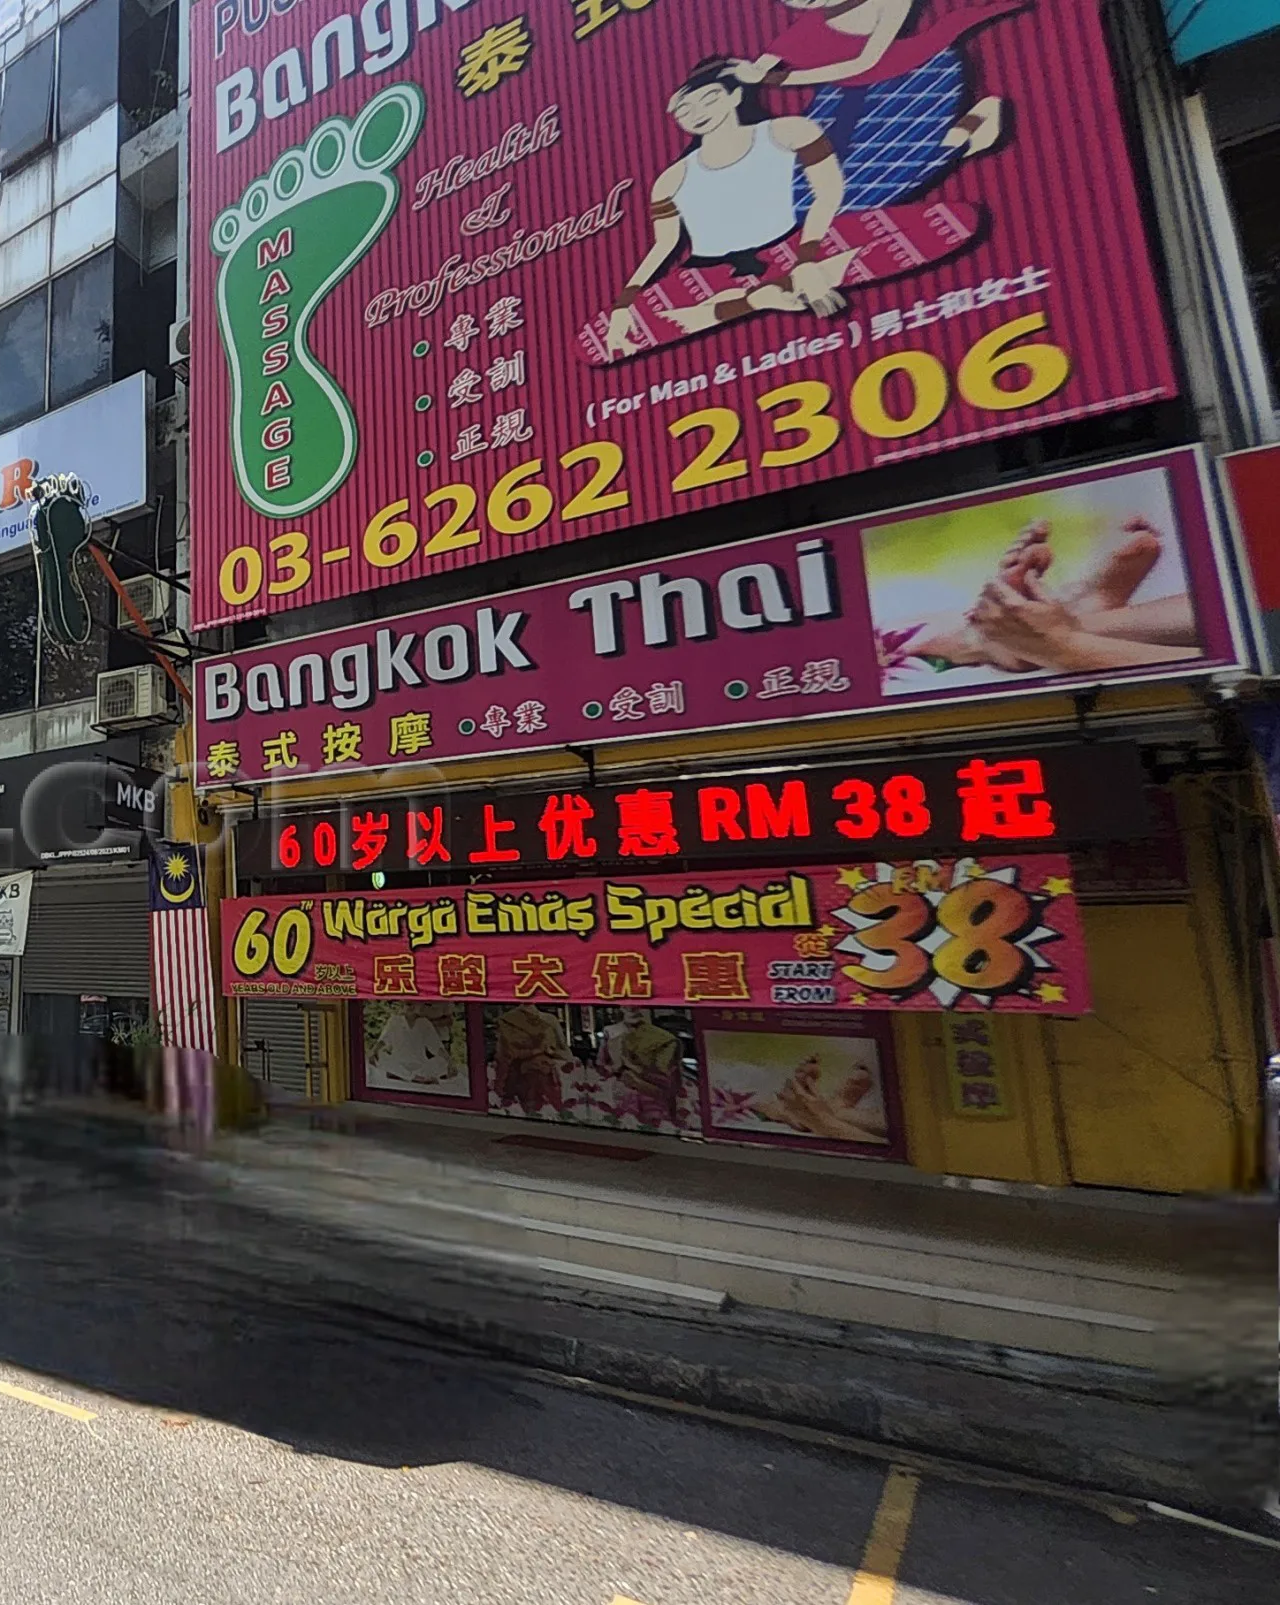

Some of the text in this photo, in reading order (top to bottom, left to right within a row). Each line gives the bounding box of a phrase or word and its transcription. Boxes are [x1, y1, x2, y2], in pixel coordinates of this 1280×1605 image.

[216, 0, 472, 153] Bang
[412, 104, 560, 210] Health
[364, 178, 634, 328] Professional
[444, 295, 525, 352] 專業
[870, 265, 1052, 342] 男士和女士
[257, 226, 294, 491] MASSAGE
[447, 351, 527, 410] 受訓
[650, 372, 709, 404] Man
[713, 362, 738, 385] &
[219, 438, 630, 607] 03-6262
[667, 311, 1072, 493] 2306
[450, 407, 534, 462] 正規
[204, 538, 835, 721] Bangkok Thai
[609, 681, 686, 722] 受訓
[756, 659, 850, 700] 正規
[206, 711, 434, 778] 泰式按摩
[116, 781, 157, 813] MKB
[698, 781, 811, 842] RM
[832, 776, 931, 839] 38
[956, 759, 1056, 841] 起
[232, 899, 315, 979] 60 TH
[322, 898, 458, 949] Warga
[466, 892, 596, 936] Emas
[840, 879, 1034, 995] 38
[231, 982, 358, 996] YEARS OLD AND ABOVE
[373, 951, 751, 1002] 乐龄大优惠
[768, 960, 834, 980] START
[771, 986, 834, 1004] FROM
